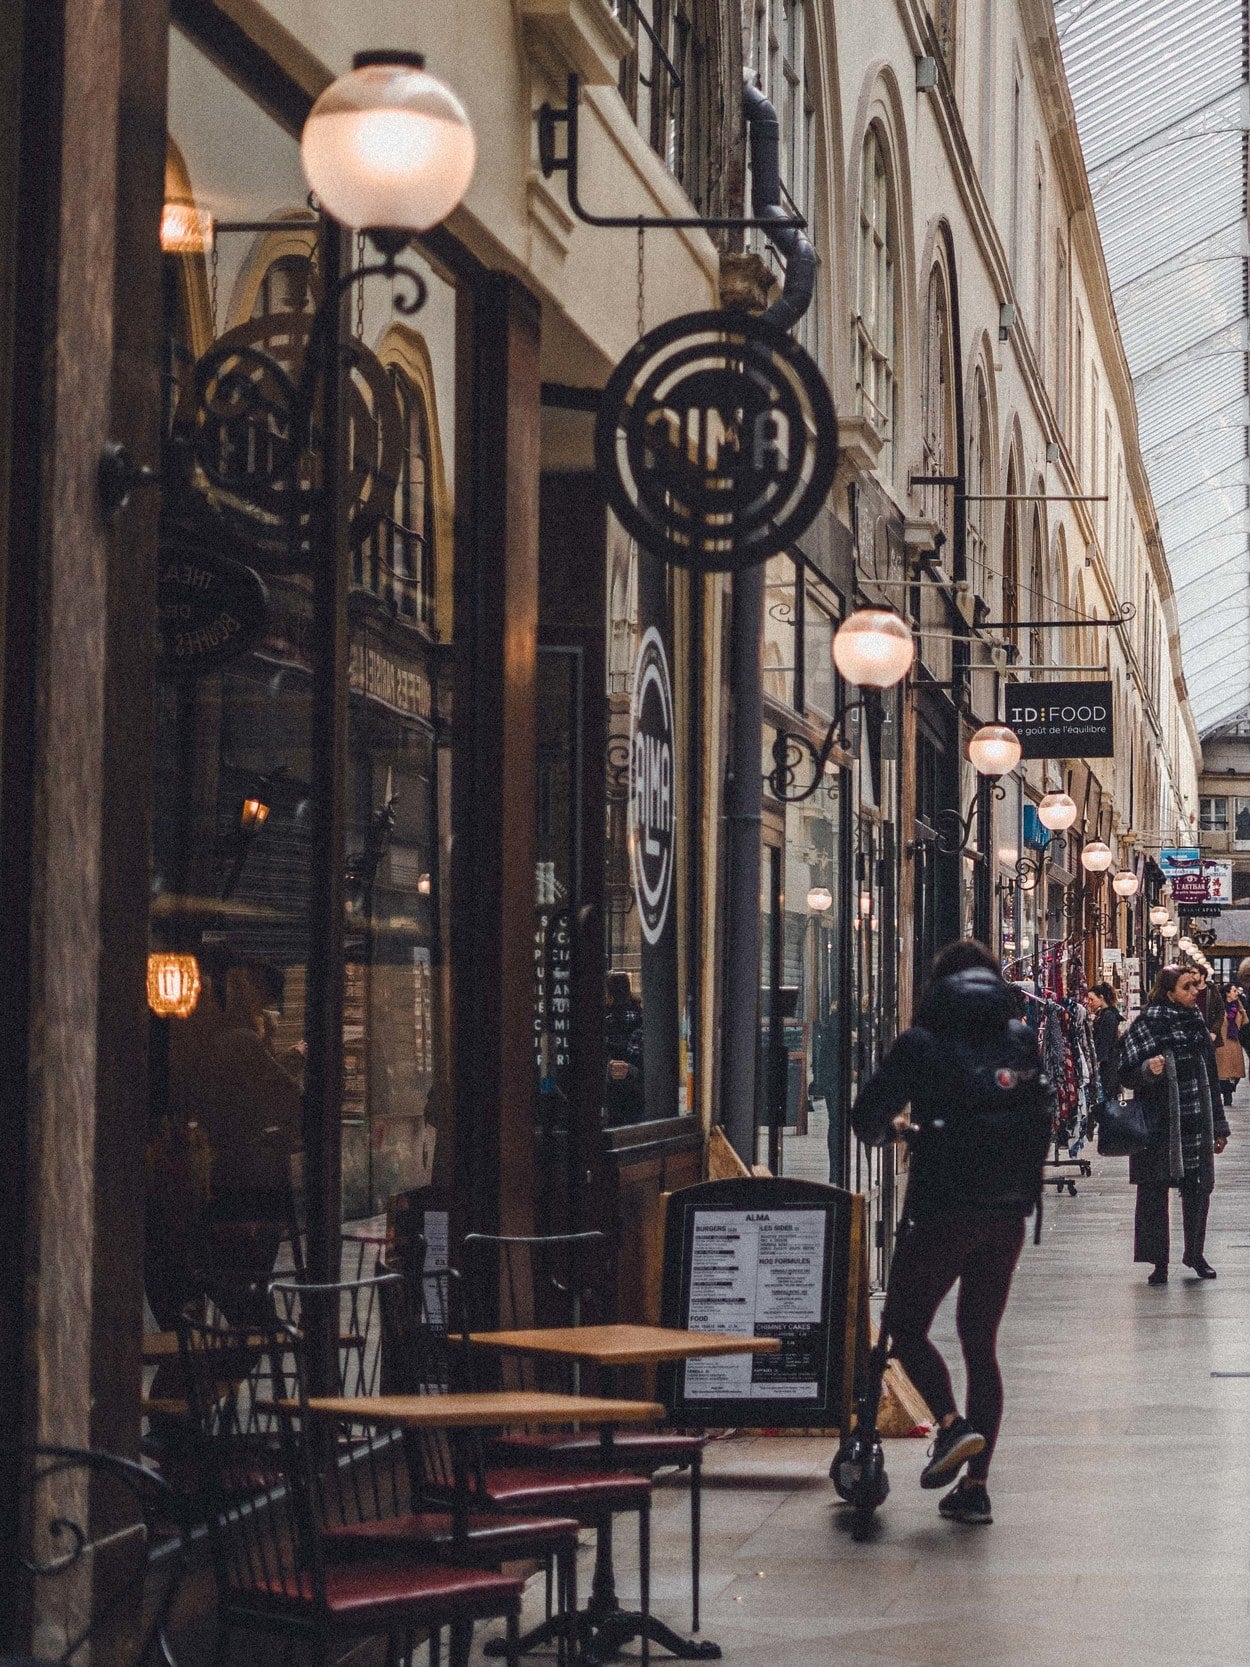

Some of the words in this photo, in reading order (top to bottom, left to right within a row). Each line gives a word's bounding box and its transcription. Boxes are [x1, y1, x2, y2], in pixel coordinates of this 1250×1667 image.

[1025, 726, 1047, 736] goût
[1049, 726, 1061, 735] de
[1062, 725, 1107, 736] l'équilibre
[745, 1214, 770, 1222] ALMA
